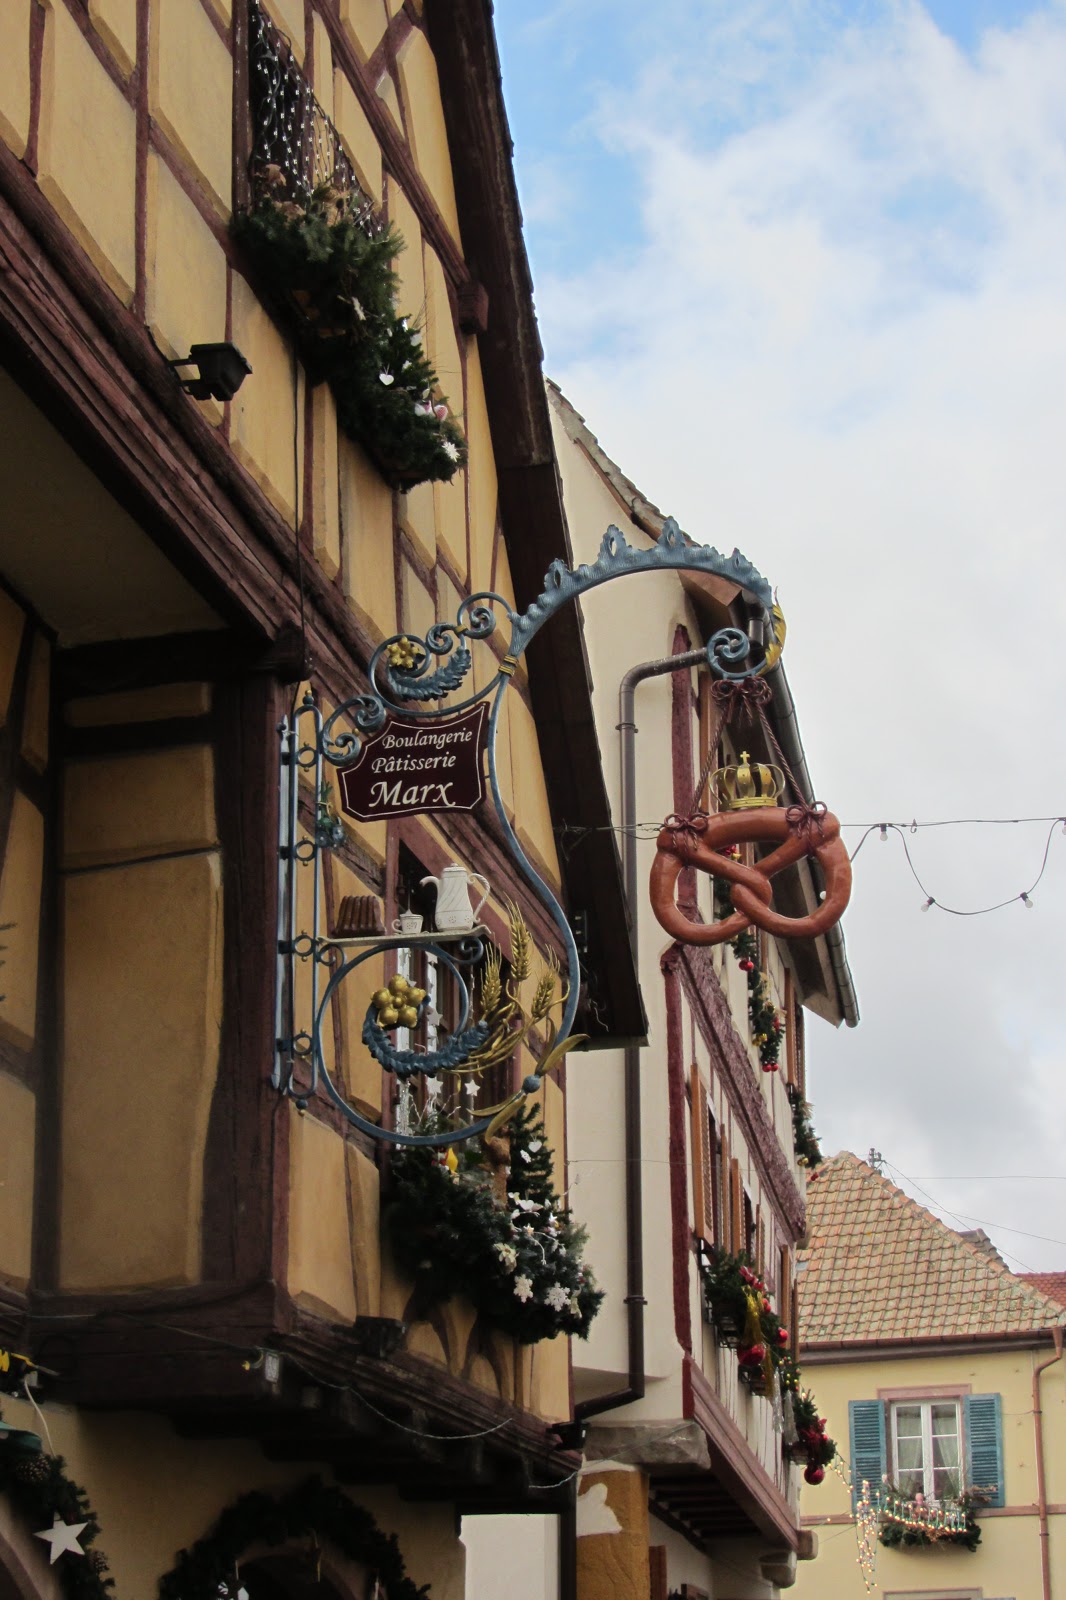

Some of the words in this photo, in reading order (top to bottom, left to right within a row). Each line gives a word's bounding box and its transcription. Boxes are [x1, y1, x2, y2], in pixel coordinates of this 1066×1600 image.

[382, 727, 473, 749] Boulangerie
[371, 751, 456, 773] Pâtisserie
[368, 780, 456, 807] Marx
